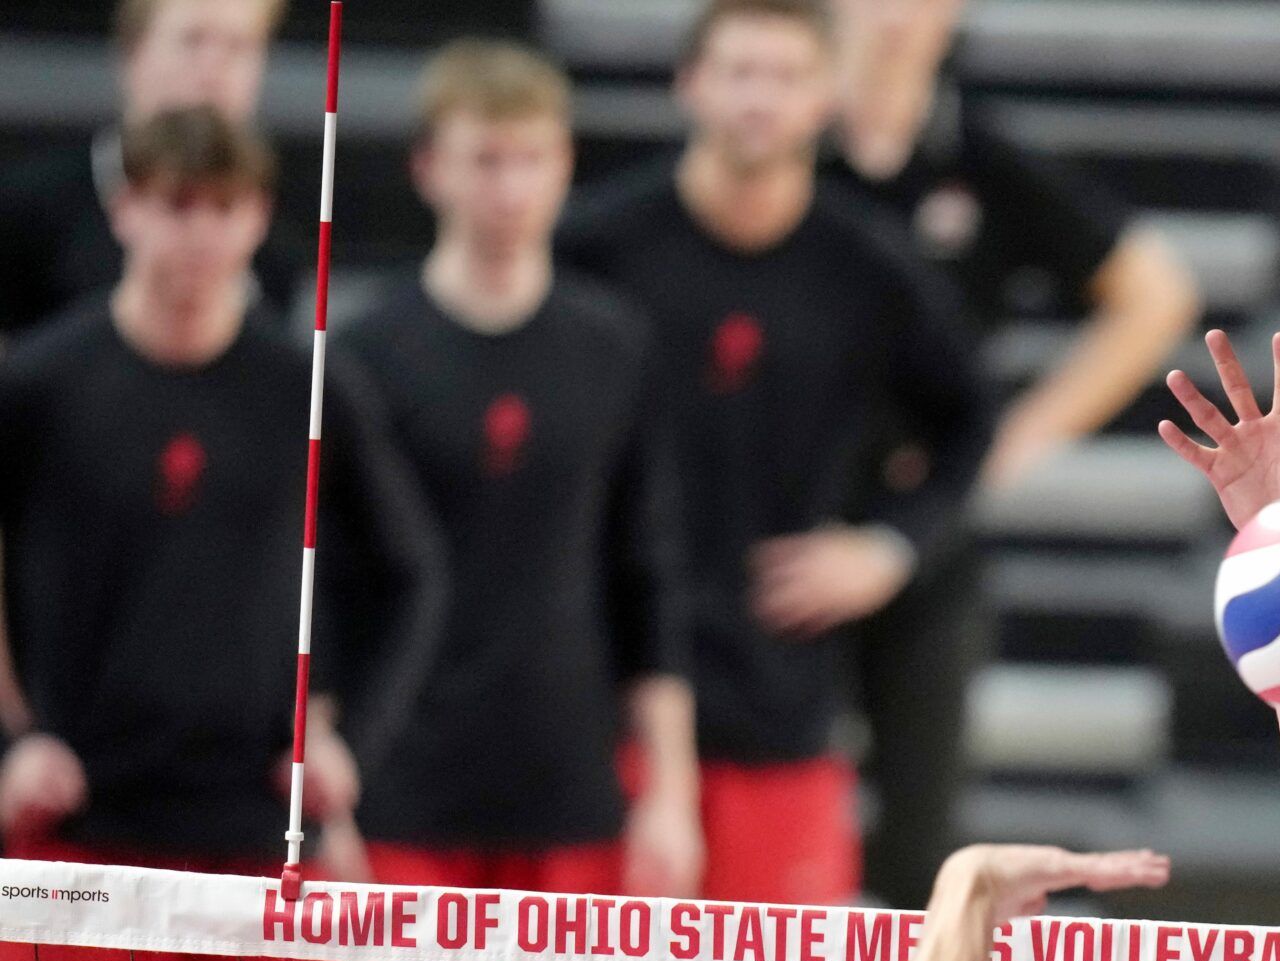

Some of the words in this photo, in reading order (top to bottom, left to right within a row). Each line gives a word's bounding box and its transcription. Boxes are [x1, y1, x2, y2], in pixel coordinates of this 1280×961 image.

[1, 885, 49, 900] sports
[51, 889, 110, 904] imports
[262, 888, 419, 948] HOME
[436, 893, 501, 950] OF
[517, 896, 651, 958] OHIO
